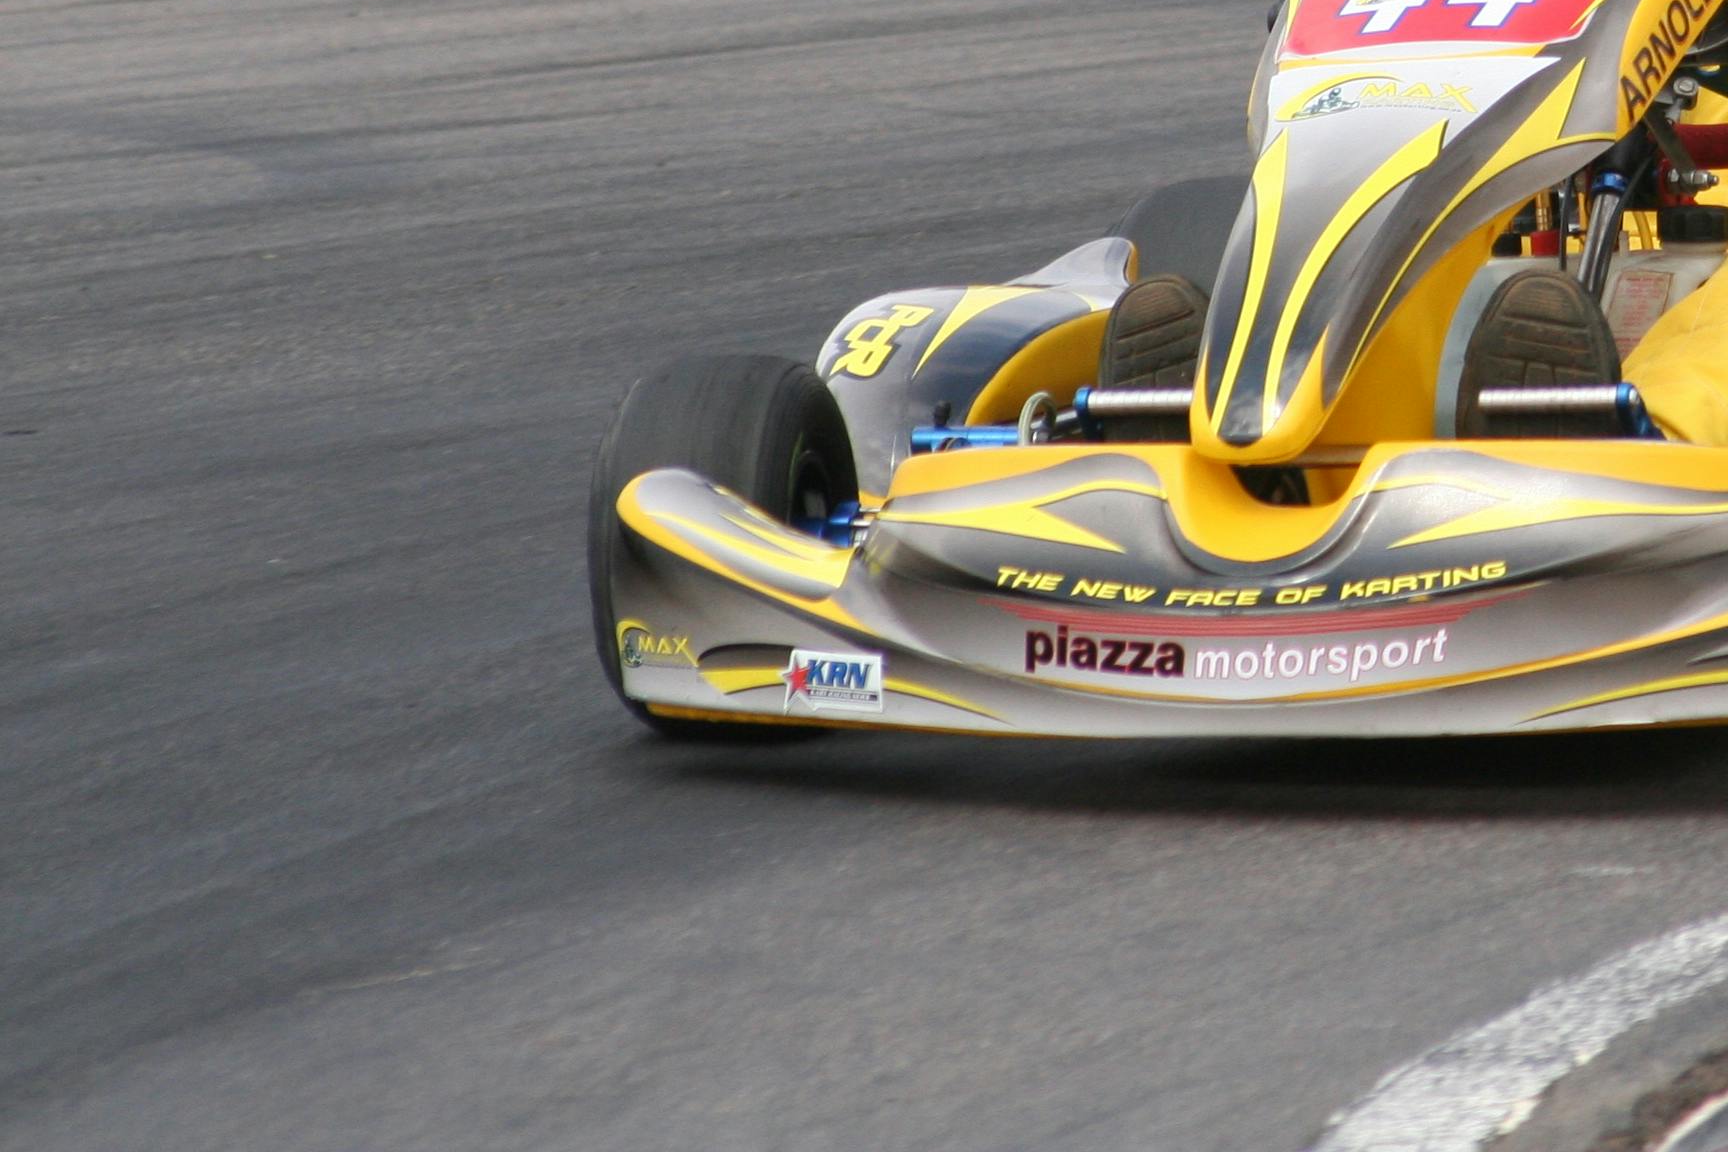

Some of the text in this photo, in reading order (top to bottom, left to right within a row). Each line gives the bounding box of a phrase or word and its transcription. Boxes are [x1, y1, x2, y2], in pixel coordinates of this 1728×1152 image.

[1360, 82, 1478, 113] MAX
[996, 561, 1507, 607] THE NEW FACE OF KARTING
[637, 636, 698, 668] MAX
[1024, 625, 1448, 682] piazza motorsport
[807, 659, 871, 689] KRN
